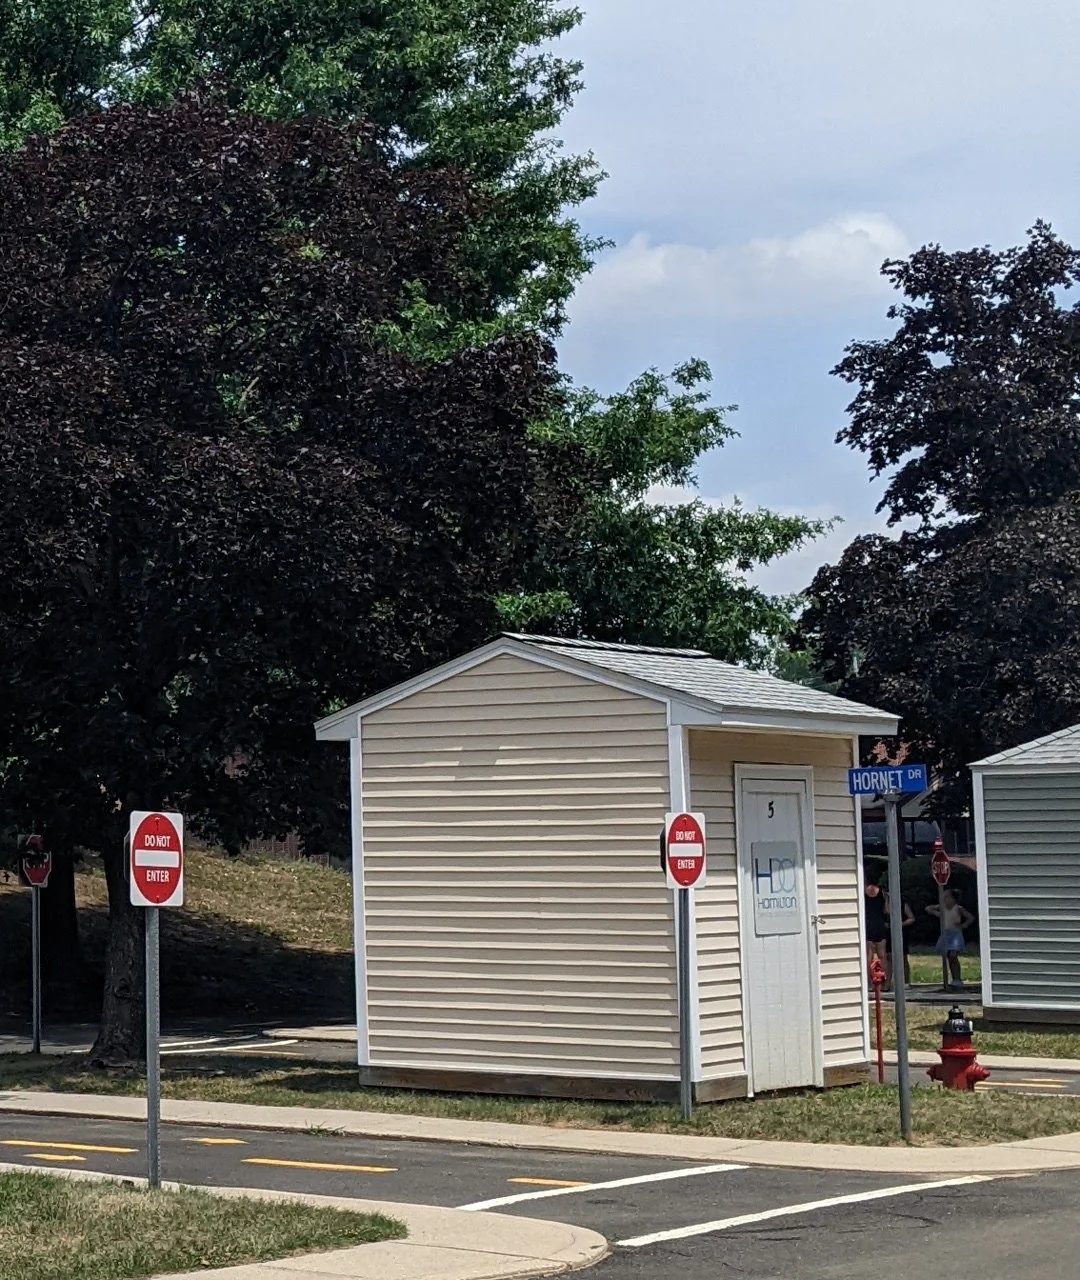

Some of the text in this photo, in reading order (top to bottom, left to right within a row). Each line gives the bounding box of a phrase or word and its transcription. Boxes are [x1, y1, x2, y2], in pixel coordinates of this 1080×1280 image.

[852, 769, 922, 791] HORNET DR
[767, 800, 775, 818] 5
[144, 834, 171, 847] DO NOT
[675, 831, 696, 841] DO NOT
[677, 859, 696, 870] ENTER
[932, 861, 948, 874] STOP
[146, 870, 170, 883] ENTER
